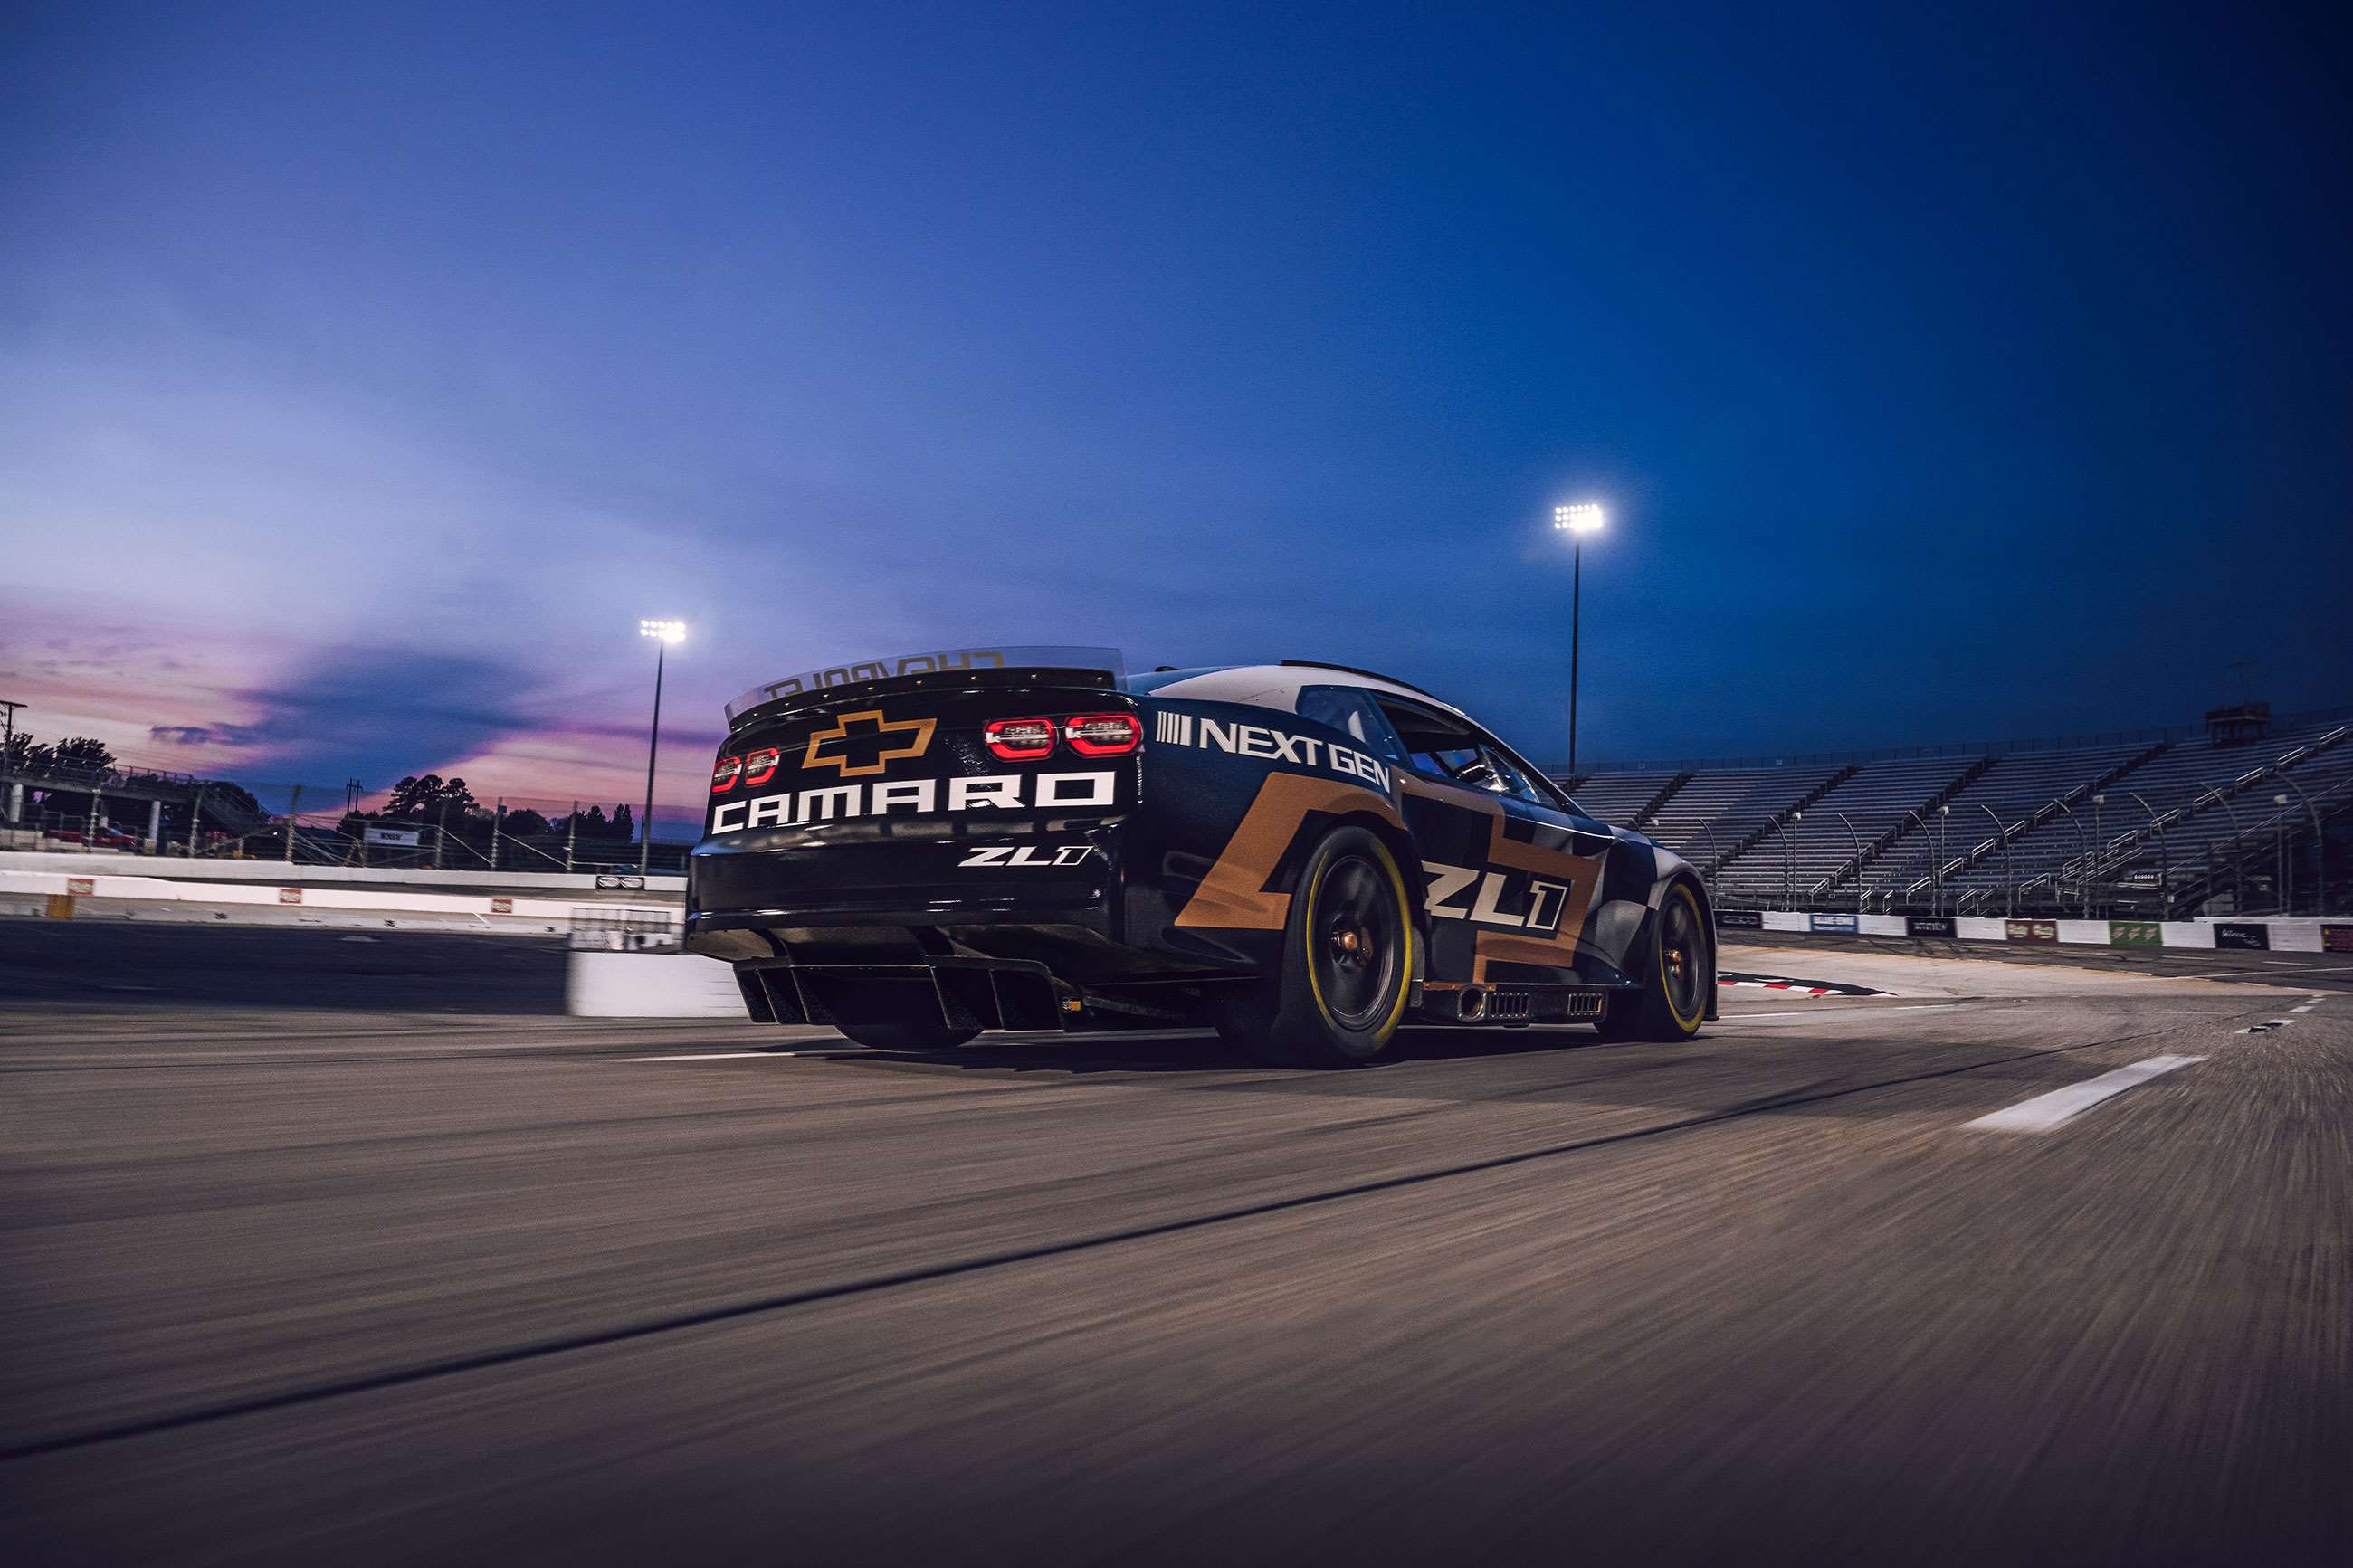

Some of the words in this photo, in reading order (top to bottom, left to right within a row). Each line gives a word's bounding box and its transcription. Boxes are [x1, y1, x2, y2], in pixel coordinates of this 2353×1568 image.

[1198, 717, 1323, 766] NEXT
[1328, 743, 1390, 794] GEN
[711, 771, 1116, 835] CAMARO
[957, 846, 1094, 867] ZL1
[1420, 860, 1568, 931] ZL1
